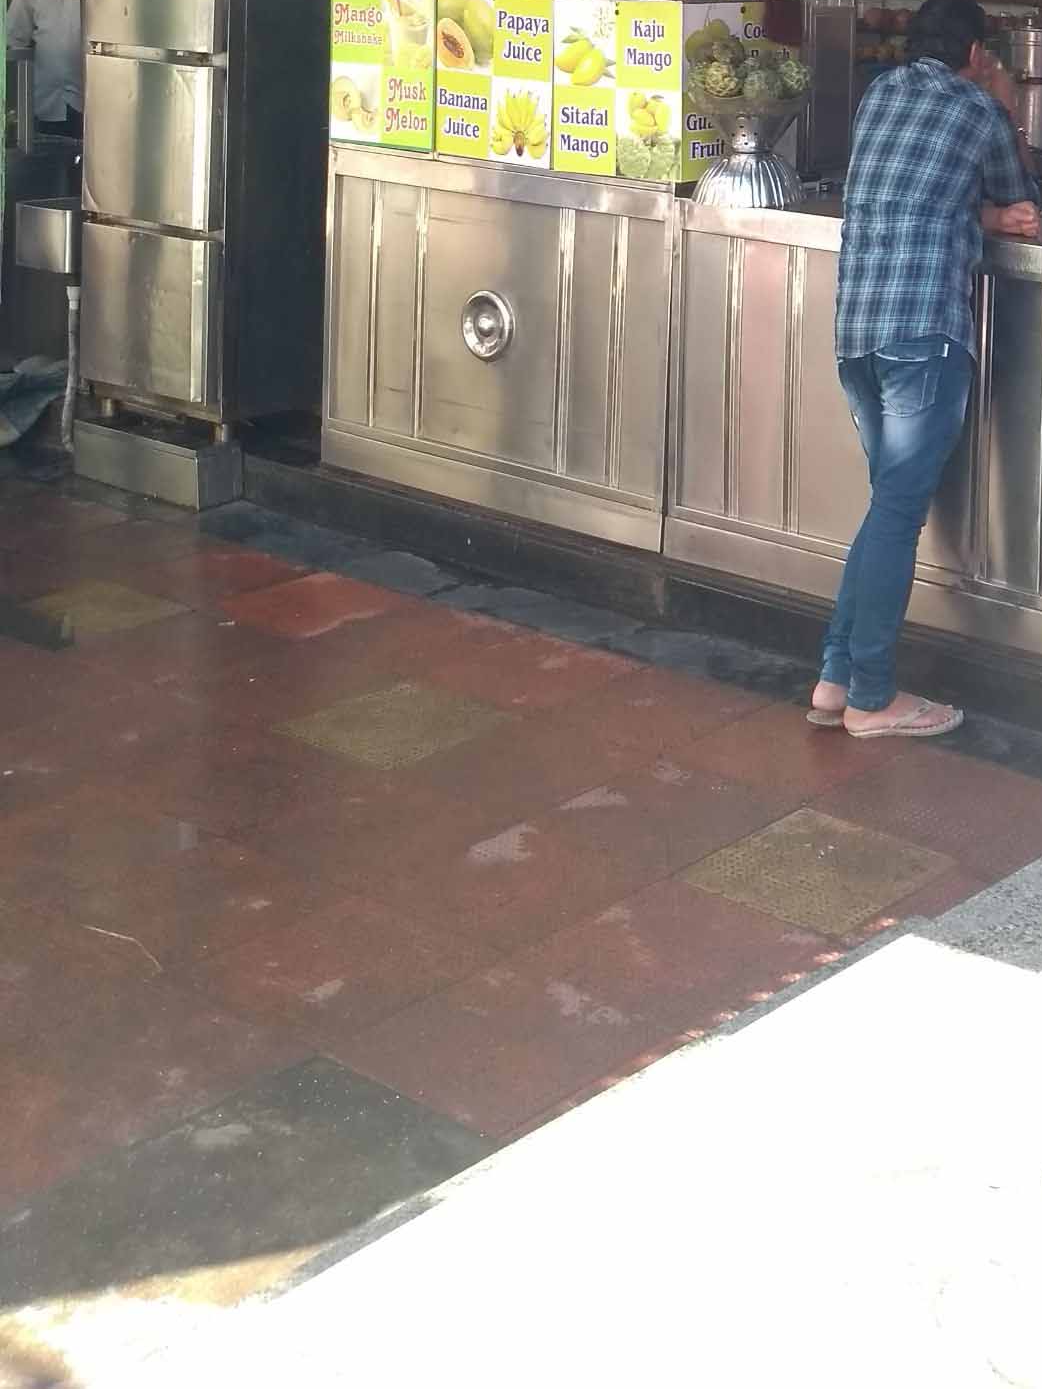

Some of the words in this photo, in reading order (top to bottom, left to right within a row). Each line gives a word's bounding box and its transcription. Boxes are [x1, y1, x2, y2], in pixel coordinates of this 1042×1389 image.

[334, 3, 382, 26] Mango
[498, 11, 549, 36] Papaya
[634, 20, 665, 42] Kaju
[503, 41, 542, 62] Juice
[626, 48, 672, 71] Mango
[389, 78, 426, 102] Musk
[439, 89, 488, 111] Banana
[385, 108, 427, 132] Melon
[444, 117, 480, 138] Juice
[561, 107, 608, 126] Sitafal
[560, 135, 609, 158] Mango
